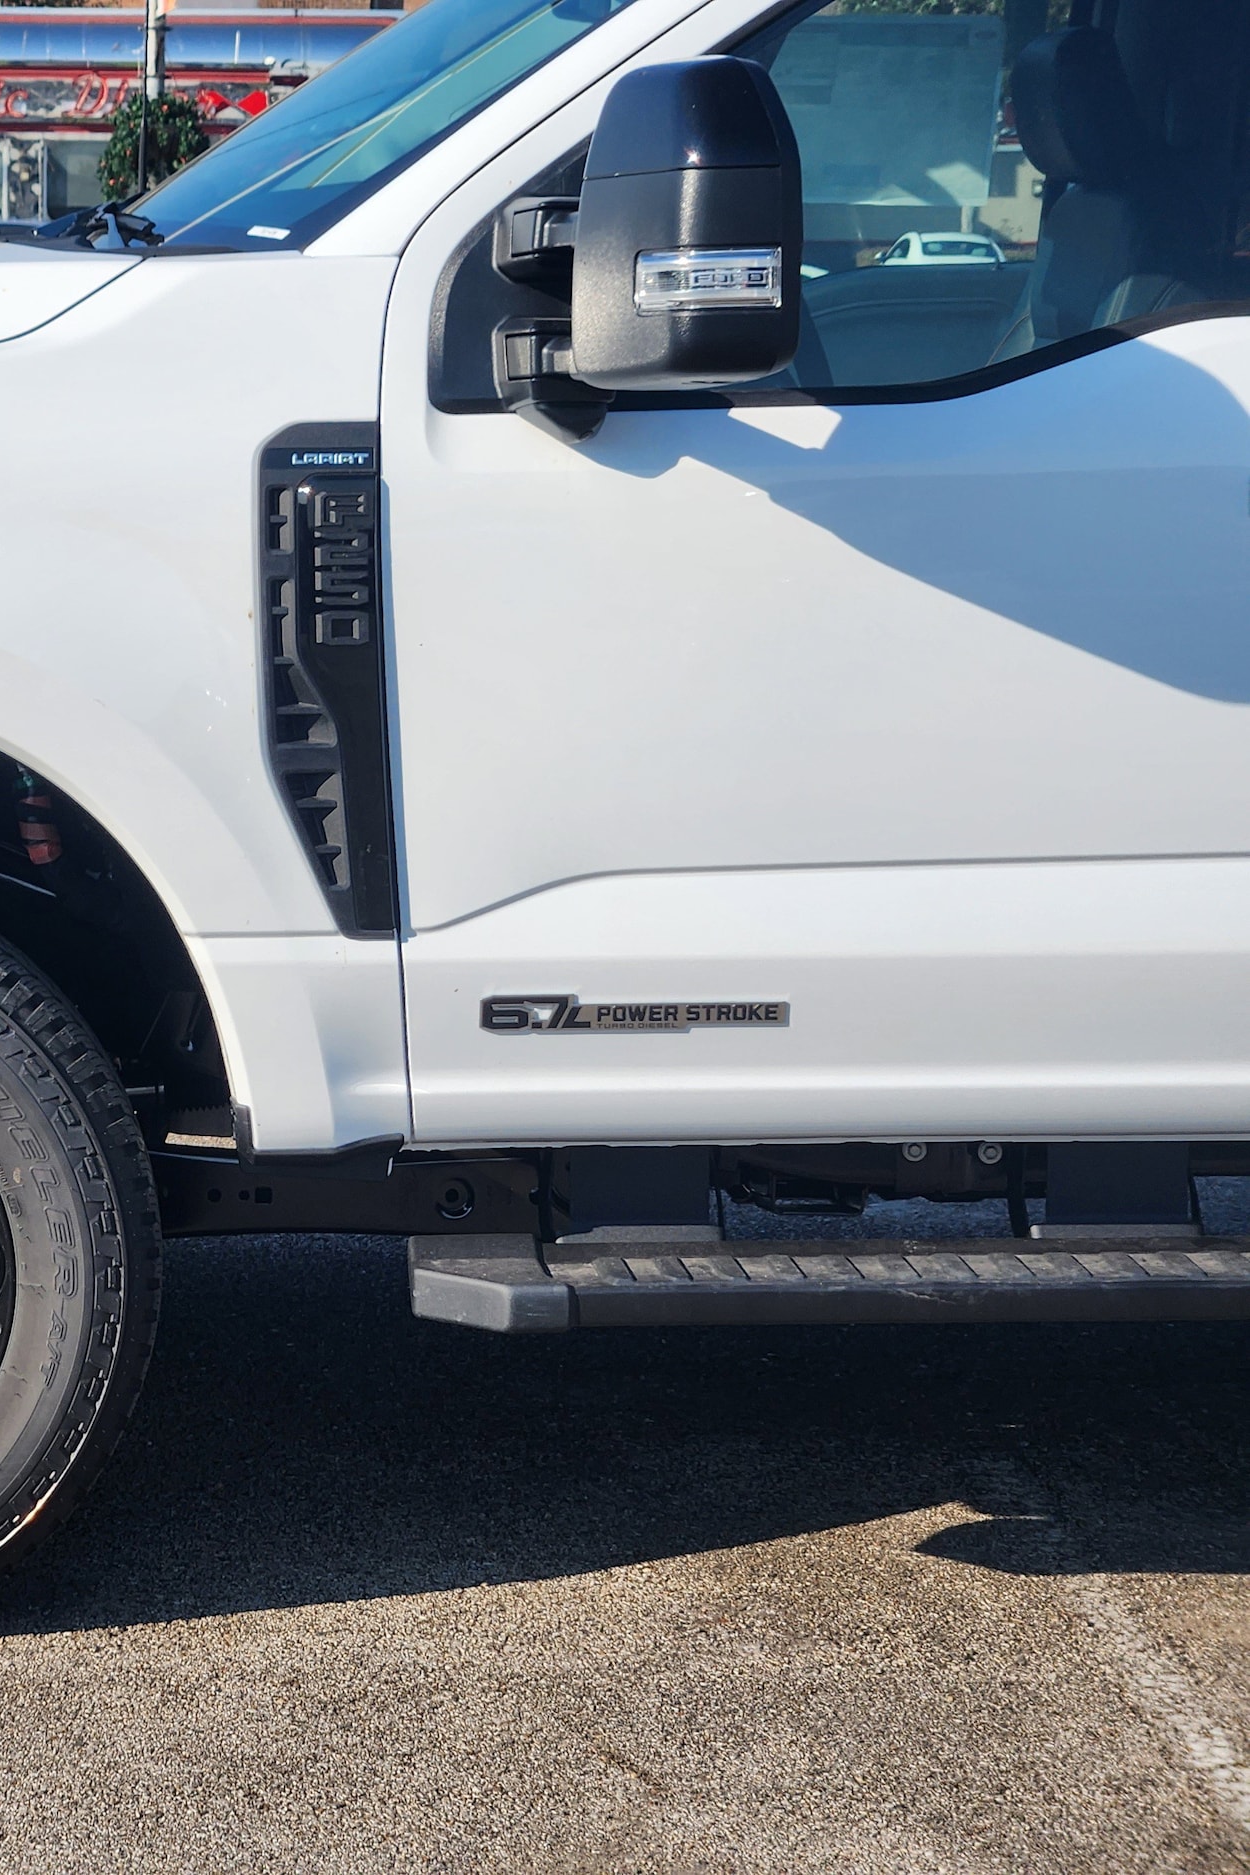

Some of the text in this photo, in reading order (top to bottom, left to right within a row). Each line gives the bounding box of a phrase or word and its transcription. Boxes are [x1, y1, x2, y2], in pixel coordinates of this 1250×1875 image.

[291, 452, 369, 465] LARIAT
[482, 996, 779, 1029] 6.7L POWER STROKE
[638, 1021, 679, 1029] DIESEL
